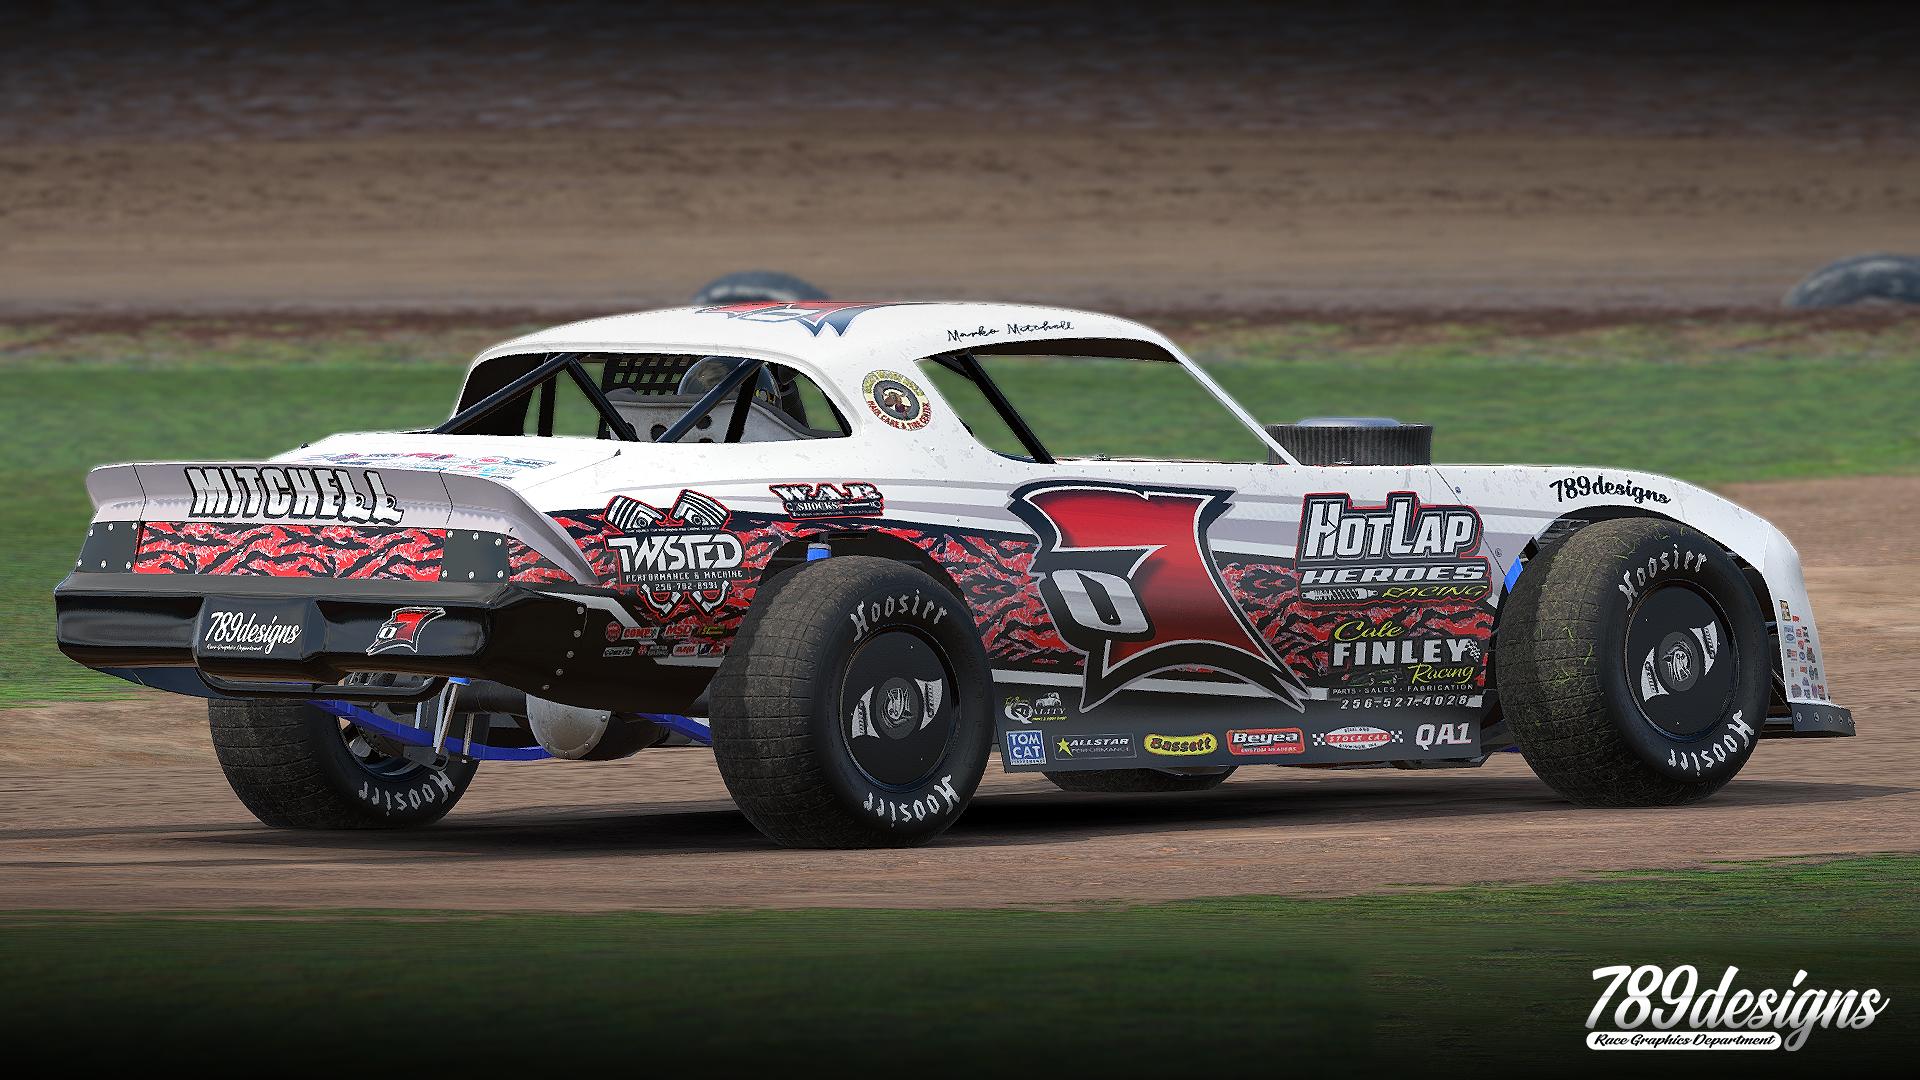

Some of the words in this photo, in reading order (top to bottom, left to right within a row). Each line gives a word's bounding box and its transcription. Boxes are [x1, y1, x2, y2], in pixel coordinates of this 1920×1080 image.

[184, 466, 405, 526] MITCHELL
[1548, 475, 1672, 504] 789designs
[797, 501, 839, 511] SHOCKS
[607, 533, 743, 573] TWISTED
[625, 571, 690, 583] PERFORMANCE
[703, 569, 743, 580] MACHINE
[1300, 565, 1487, 585] HEROES
[1381, 585, 1488, 599] RACING
[204, 611, 303, 655] 789designs
[1333, 620, 1404, 641] Cale
[1332, 638, 1468, 667] FINLEY
[1407, 663, 1475, 685] Racing
[1364, 687, 1396, 695] SALES
[1406, 684, 1474, 693] FABRICATION
[1009, 734, 1040, 745] TOM
[1069, 738, 1130, 747] ALLSTAR
[1150, 736, 1212, 753] Bassett
[1232, 732, 1299, 746] Beyea
[1329, 735, 1363, 743] STOCK
[1415, 722, 1473, 750] QA1
[1012, 746, 1041, 758] CAT
